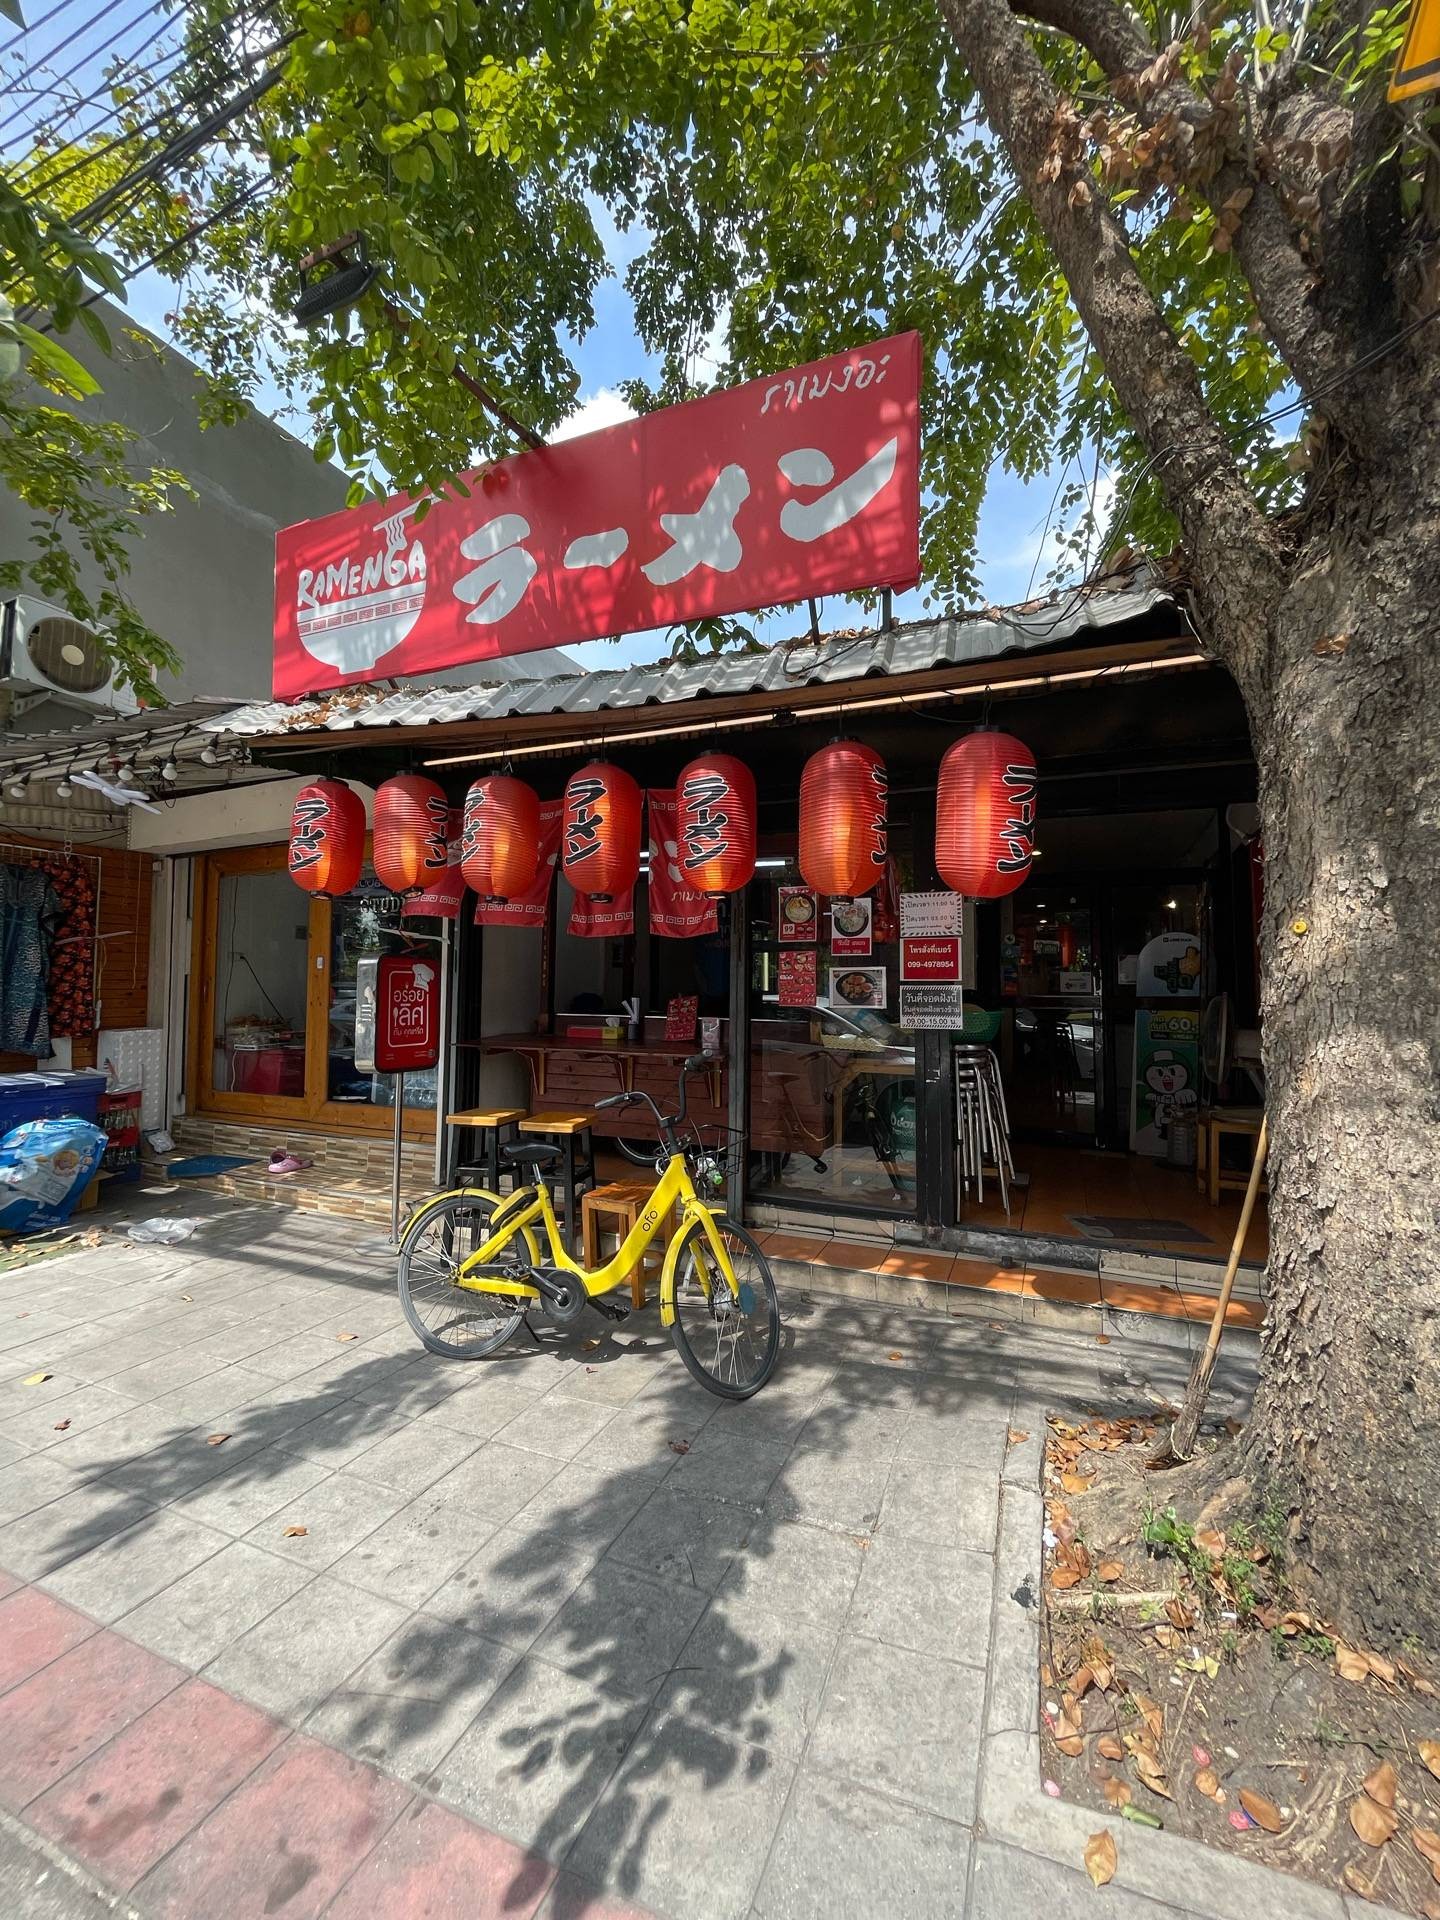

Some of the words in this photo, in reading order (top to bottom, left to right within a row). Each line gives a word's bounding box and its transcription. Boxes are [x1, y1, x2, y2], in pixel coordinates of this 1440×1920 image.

[452, 437, 898, 625] ラーメン
[297, 540, 427, 610] RAMENGA
[289, 798, 330, 873] ラーメン
[564, 778, 607, 866] ラーメン
[683, 775, 729, 869] ラーメン
[997, 765, 1038, 873] ラーメン
[393, 983, 425, 1002] อร่อย
[642, 1210, 658, 1232] ofo
